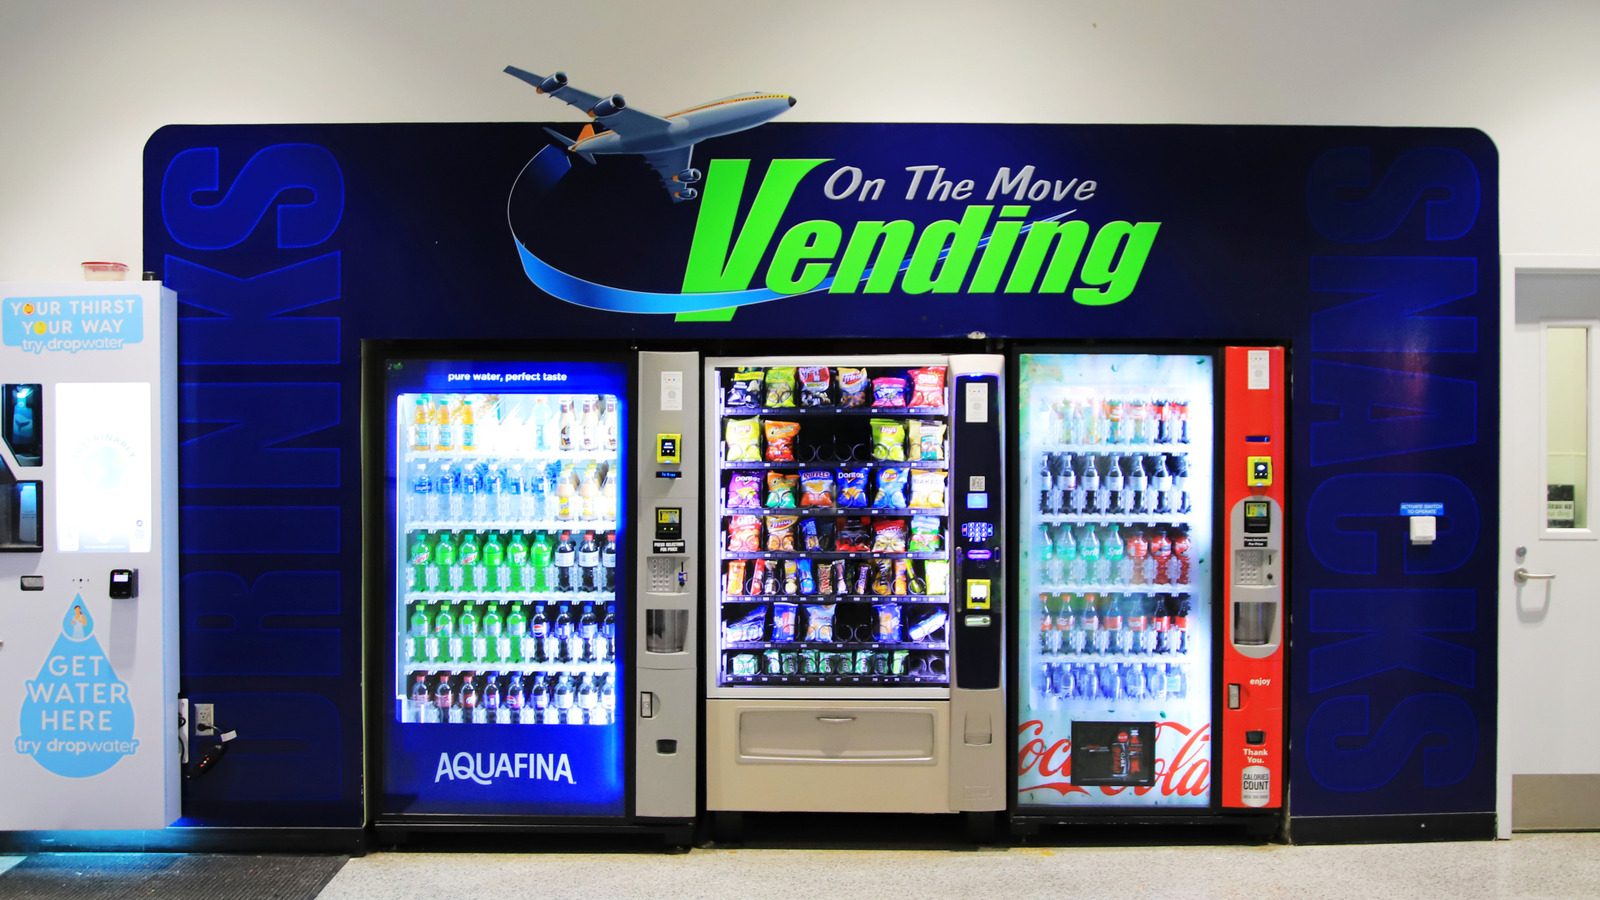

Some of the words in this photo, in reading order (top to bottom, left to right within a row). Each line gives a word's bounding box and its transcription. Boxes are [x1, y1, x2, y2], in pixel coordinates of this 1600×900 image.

[824, 166, 885, 201] On
[905, 165, 973, 201] The
[986, 165, 1098, 201] Move
[674, 158, 1163, 322] Vending
[10, 301, 62, 316] YOUR
[69, 299, 136, 314] THIRST
[22, 320, 73, 335] YOUR
[81, 319, 124, 334] WAY
[22, 339, 43, 352] try
[47, 337, 125, 351] dropwater
[448, 373, 471, 382] pure
[473, 373, 503, 382] water,
[505, 372, 541, 382] perfect
[543, 373, 568, 381] taste
[1306, 146, 1481, 792] SNACKS
[48, 656, 104, 677] GET
[1249, 678, 1271, 686] enjoy
[28, 683, 127, 704] WATER
[41, 710, 113, 731] HERE
[17, 739, 42, 754] try
[46, 738, 138, 755] dropwater
[1243, 748, 1268, 756] Thank
[434, 751, 577, 785] AQUAFINA
[1243, 773, 1270, 781] CALORIES
[1243, 781, 1269, 790] COUNT
